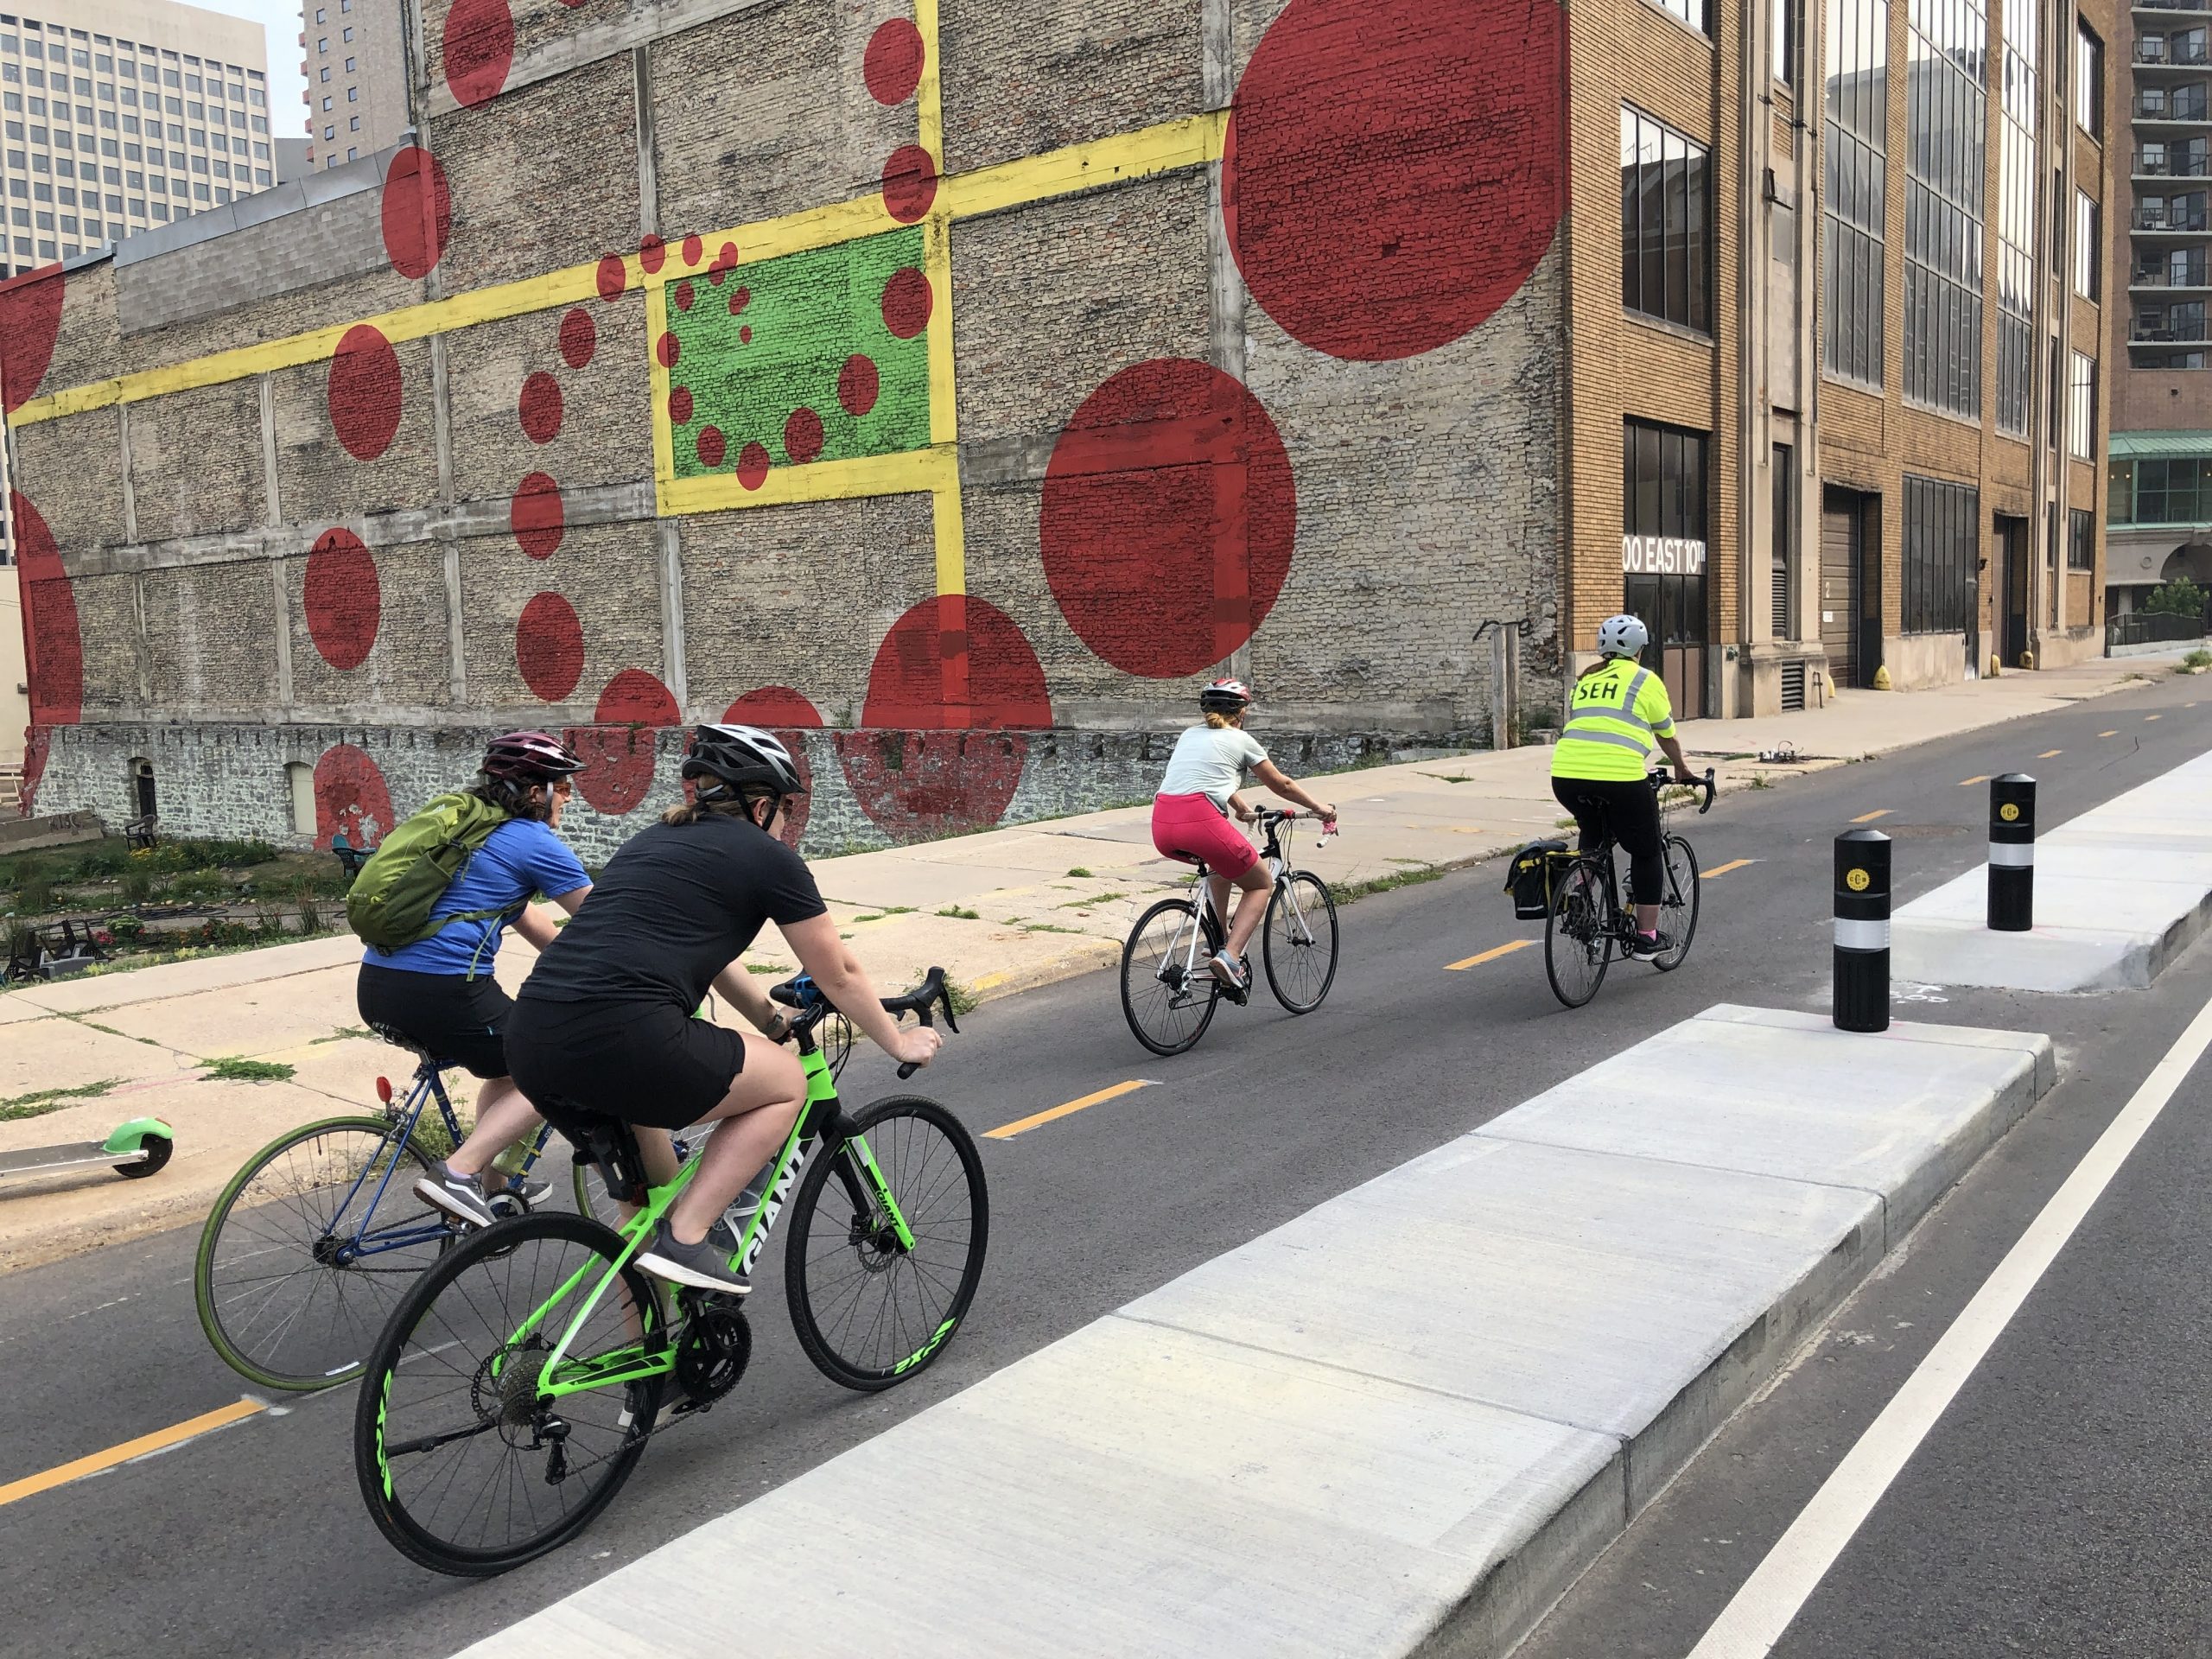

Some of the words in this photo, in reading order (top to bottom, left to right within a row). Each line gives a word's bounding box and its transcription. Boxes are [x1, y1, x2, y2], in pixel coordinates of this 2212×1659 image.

[1646, 537, 1682, 572] EAST
[1578, 682, 1618, 700] SEH
[446, 1109, 465, 1144] FUJ
[743, 1136, 804, 1276] GIANT
[876, 1191, 901, 1227] GIANT
